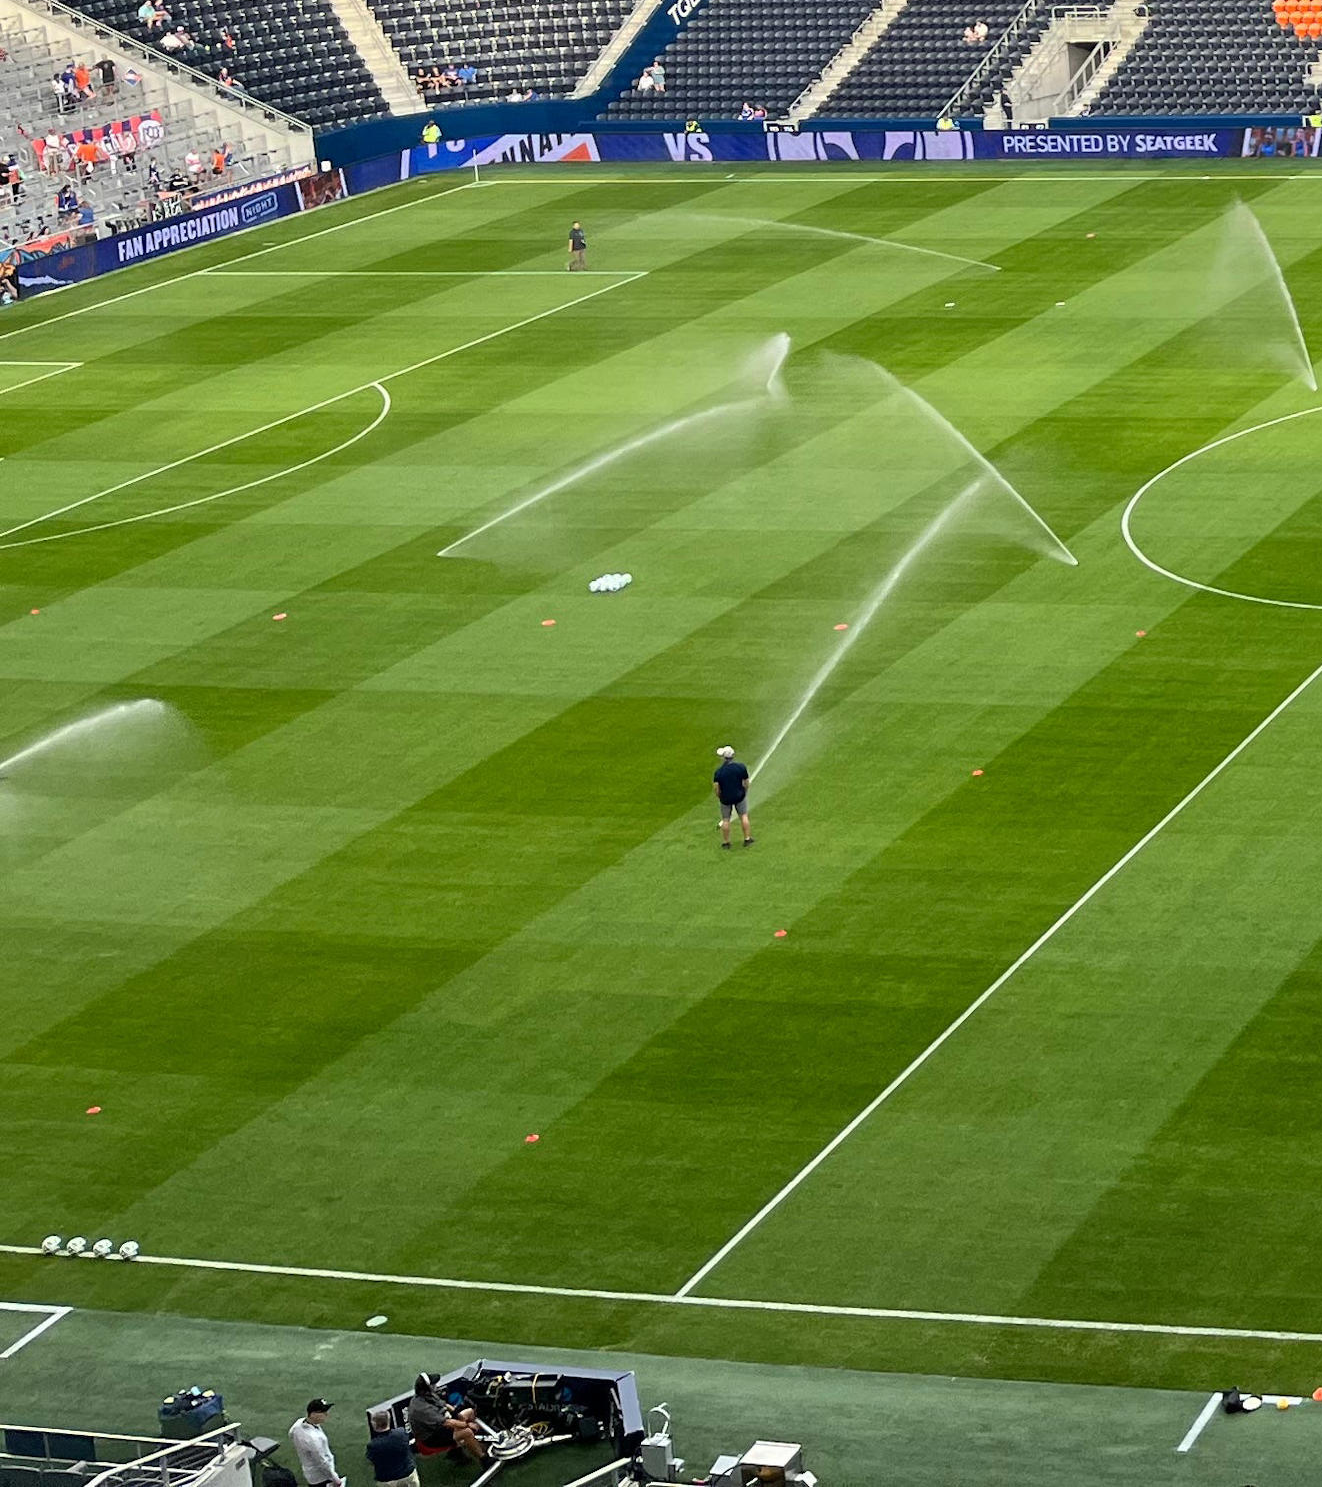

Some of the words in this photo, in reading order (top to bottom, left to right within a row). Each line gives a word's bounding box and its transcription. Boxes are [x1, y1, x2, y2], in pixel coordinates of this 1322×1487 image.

[663, 132, 714, 162] VS
[1003, 134, 1103, 153] PRESENTED
[1106, 134, 1131, 152] BY
[1135, 133, 1218, 152] SEATGEEK
[118, 239, 143, 263] FAN
[145, 207, 239, 254] APPRECIATION
[244, 196, 274, 219] NIGHT
